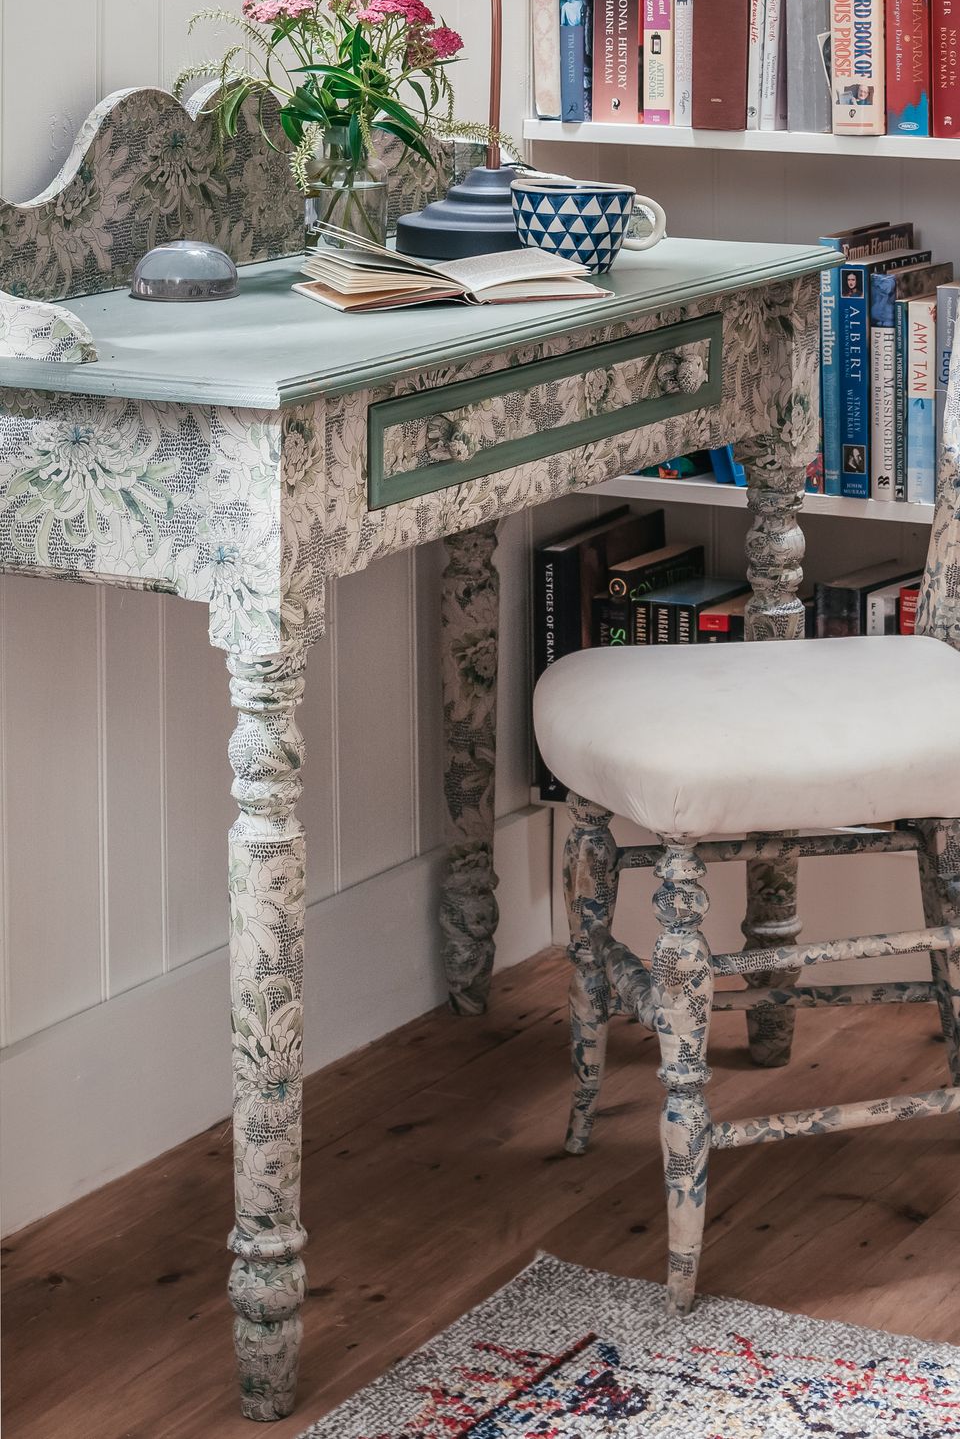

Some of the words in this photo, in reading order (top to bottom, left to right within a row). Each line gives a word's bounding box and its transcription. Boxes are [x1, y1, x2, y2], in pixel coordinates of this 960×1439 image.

[605, 38, 614, 83] GRAHAM
[835, 28, 852, 78] PROSE
[854, 22, 872, 60] BOOK
[618, 38, 628, 89] HISTORY
[649, 59, 657, 100] RANSOME
[855, 62, 872, 78] OF
[882, 332, 894, 371] HUGH
[913, 322, 927, 353] AMY
[913, 361, 927, 392] TAN
[884, 377, 894, 470] MASSINGBERD
[545, 563, 554, 612] VESTIGES
[546, 616, 554, 629] OF
